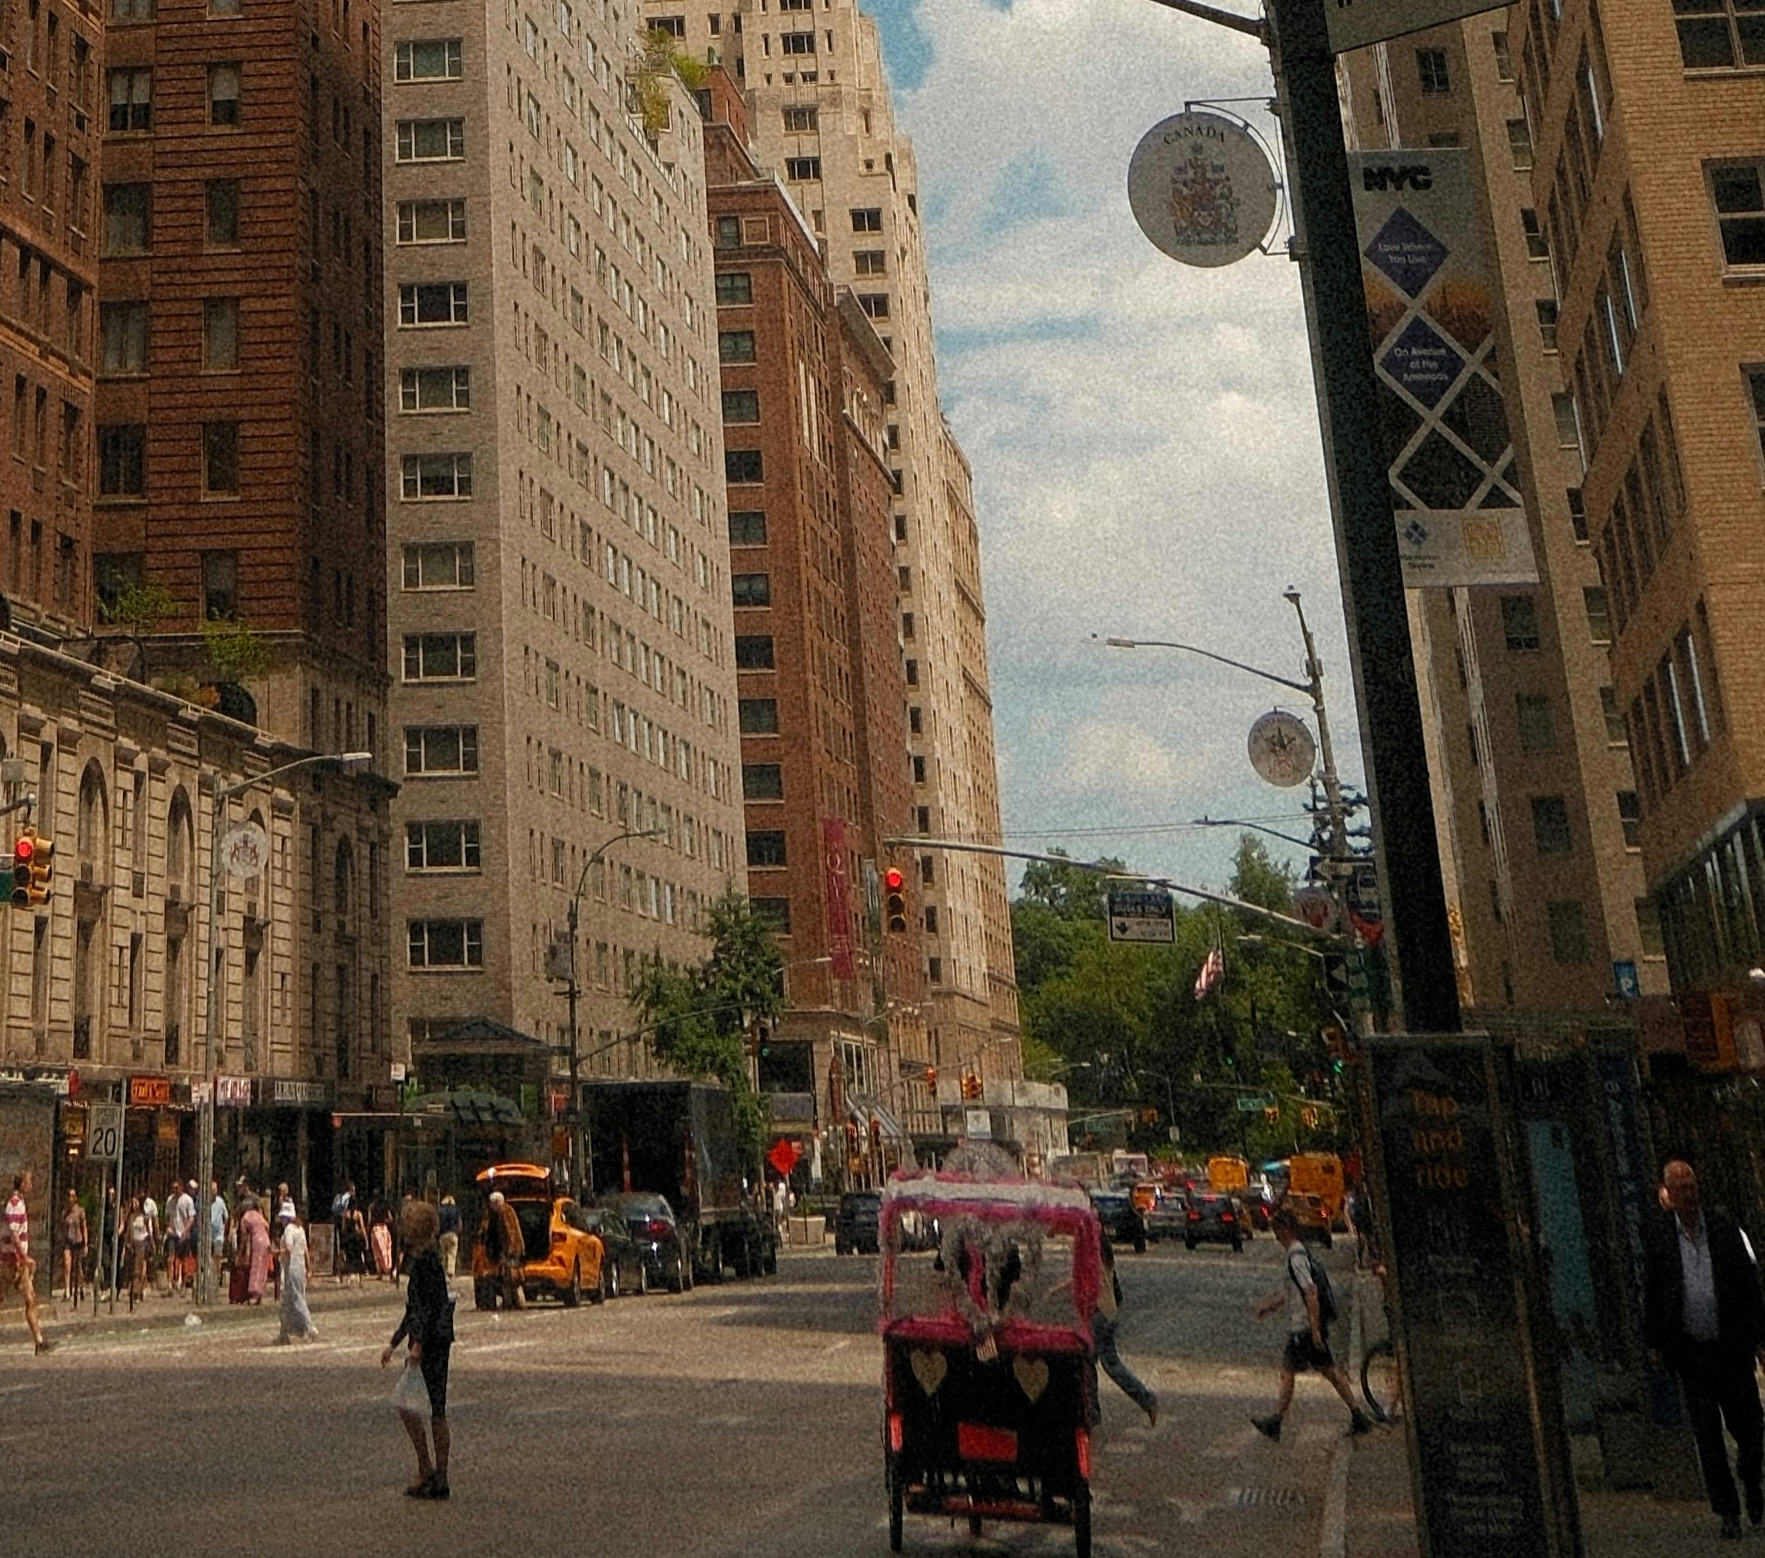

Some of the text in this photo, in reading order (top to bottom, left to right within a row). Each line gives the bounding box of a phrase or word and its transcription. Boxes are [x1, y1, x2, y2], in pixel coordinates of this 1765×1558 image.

[1162, 125, 1226, 145] CANADA
[1363, 165, 1433, 191] NYC
[91, 1127, 117, 1157] 20
